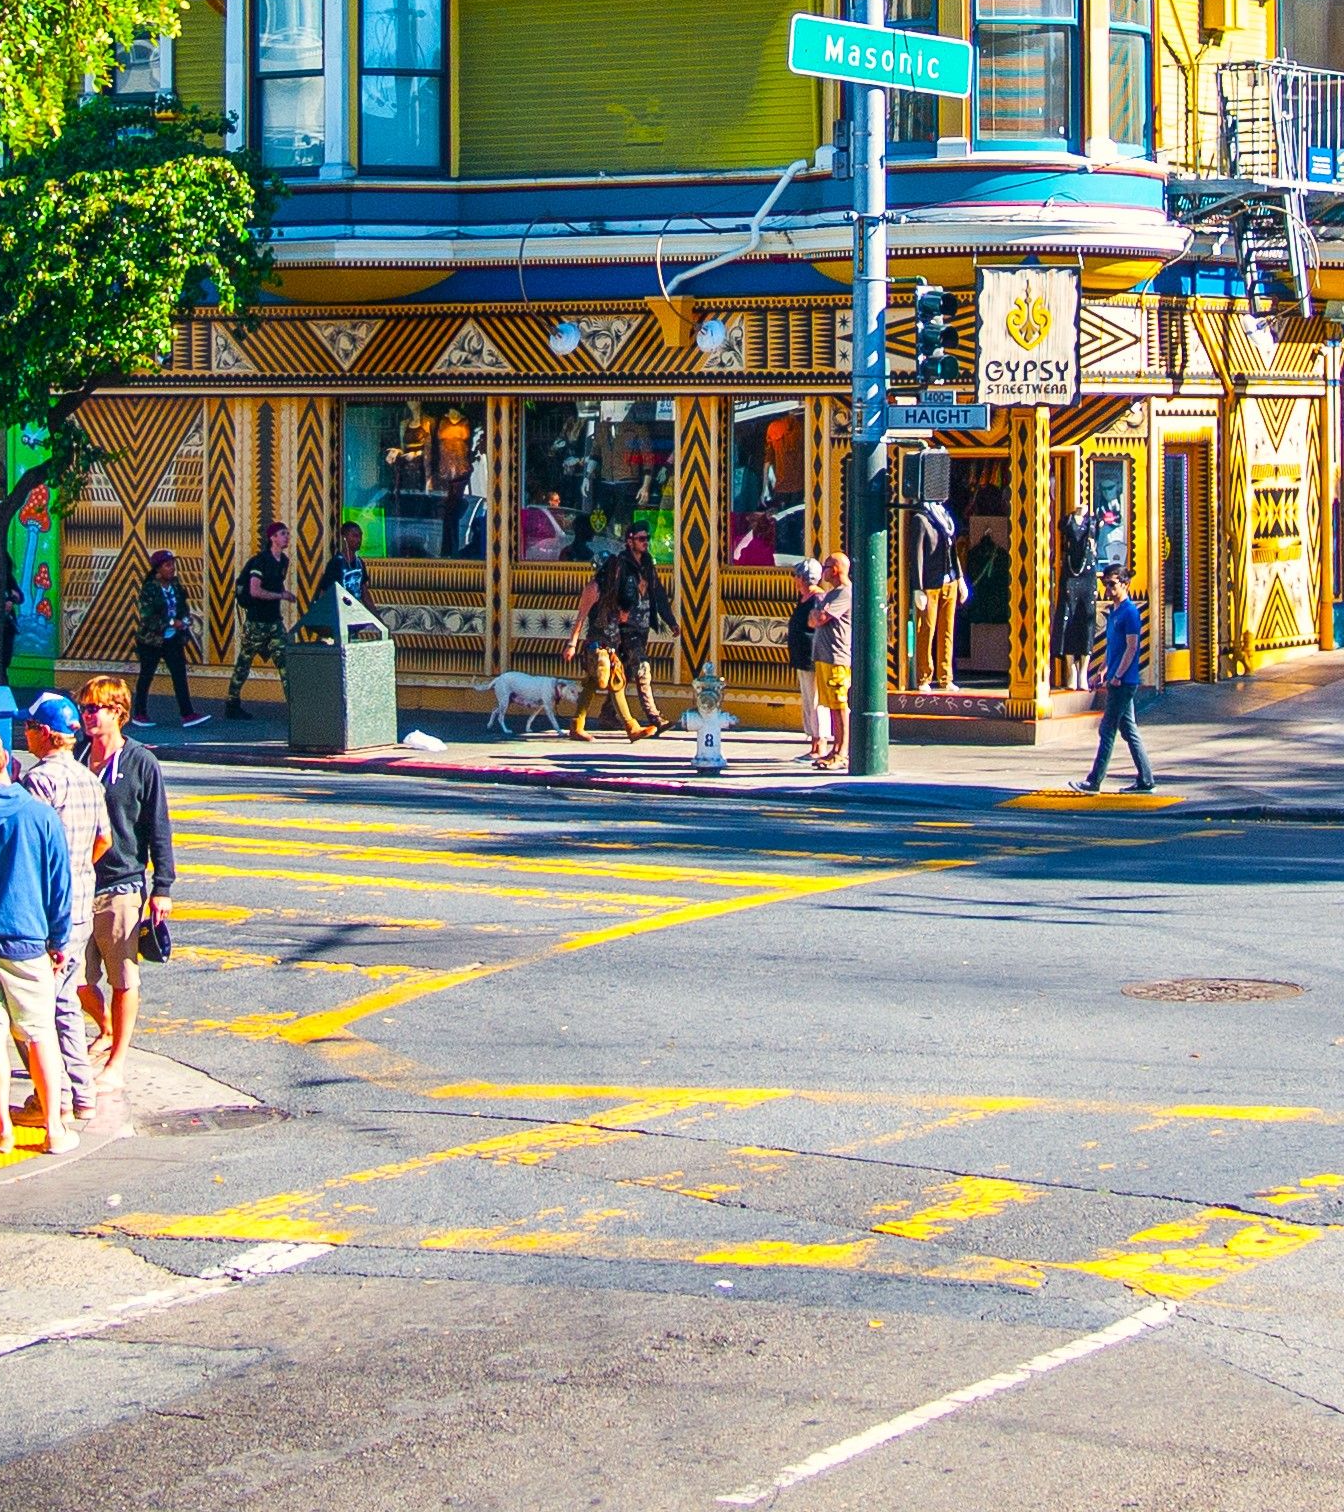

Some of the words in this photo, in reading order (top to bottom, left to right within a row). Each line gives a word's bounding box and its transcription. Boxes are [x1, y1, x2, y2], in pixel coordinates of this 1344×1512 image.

[825, 35, 939, 79] Masonic
[985, 360, 1068, 382] GYPSY
[986, 383, 1068, 395] STREETWEAR
[924, 391, 945, 403] 1400
[906, 409, 971, 425] HAIGHT
[704, 733, 714, 747] 8
